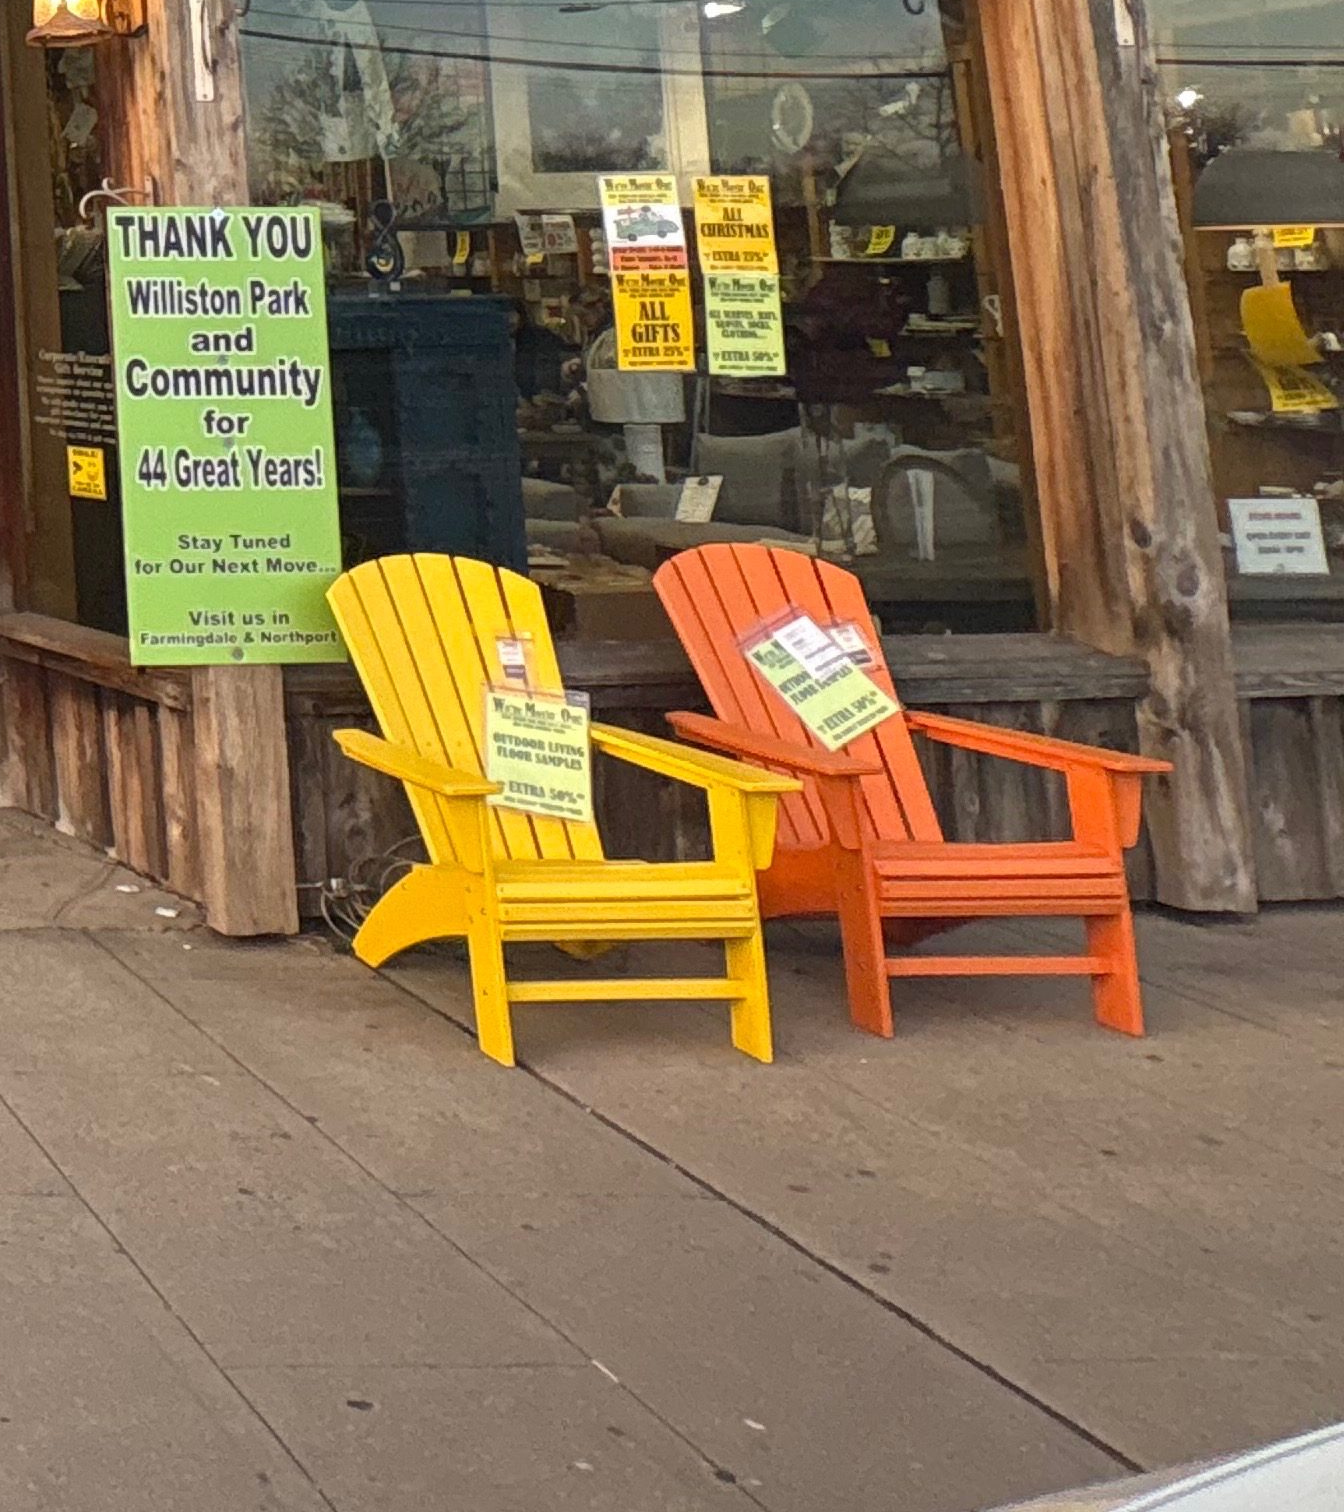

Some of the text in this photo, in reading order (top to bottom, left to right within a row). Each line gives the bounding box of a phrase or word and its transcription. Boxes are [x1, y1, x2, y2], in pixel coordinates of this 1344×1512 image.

[115, 215, 312, 259] THANK YOU
[127, 279, 309, 317] Williston Park
[639, 301, 670, 321] ALL
[191, 327, 254, 352] and
[631, 323, 680, 343] GIFTS
[126, 359, 321, 406] Community
[204, 410, 250, 435] for
[138, 448, 323, 489] 44 Great Years!
[178, 534, 291, 553] Stay Tuned
[134, 557, 337, 575] for Our Next Move...
[188, 610, 290, 628] Visit us in
[140, 630, 337, 648] Farmingdale & Northport
